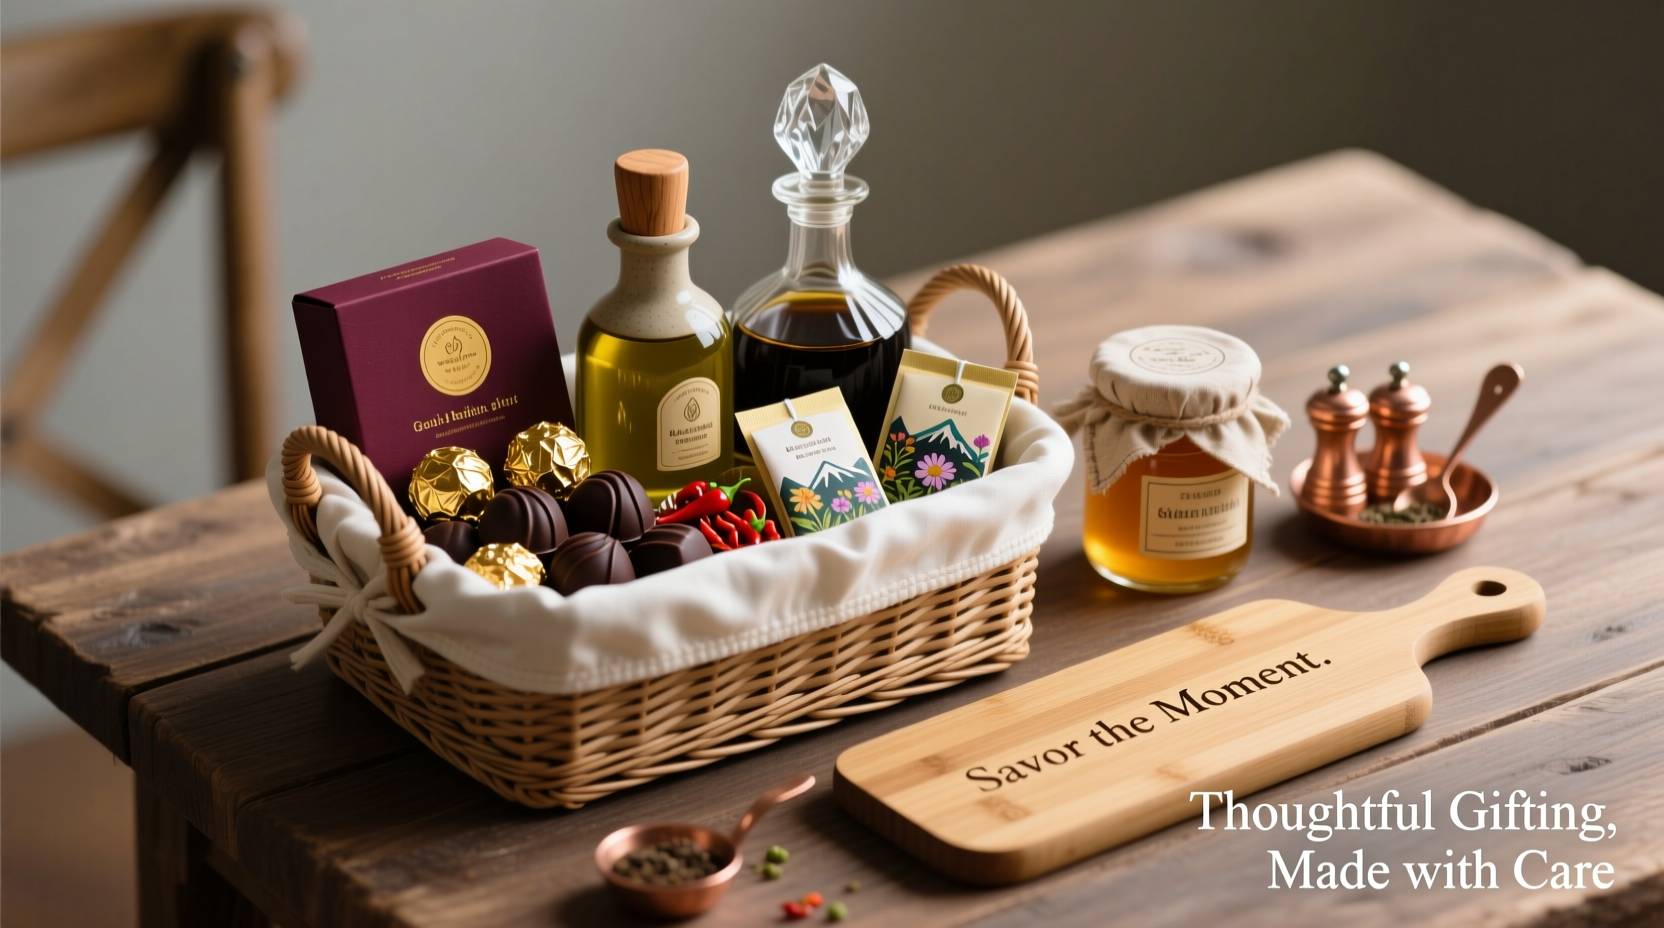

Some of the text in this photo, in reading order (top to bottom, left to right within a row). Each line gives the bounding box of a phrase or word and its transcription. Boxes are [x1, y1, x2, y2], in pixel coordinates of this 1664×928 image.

[966, 652, 1331, 792] Savor the Moment.
